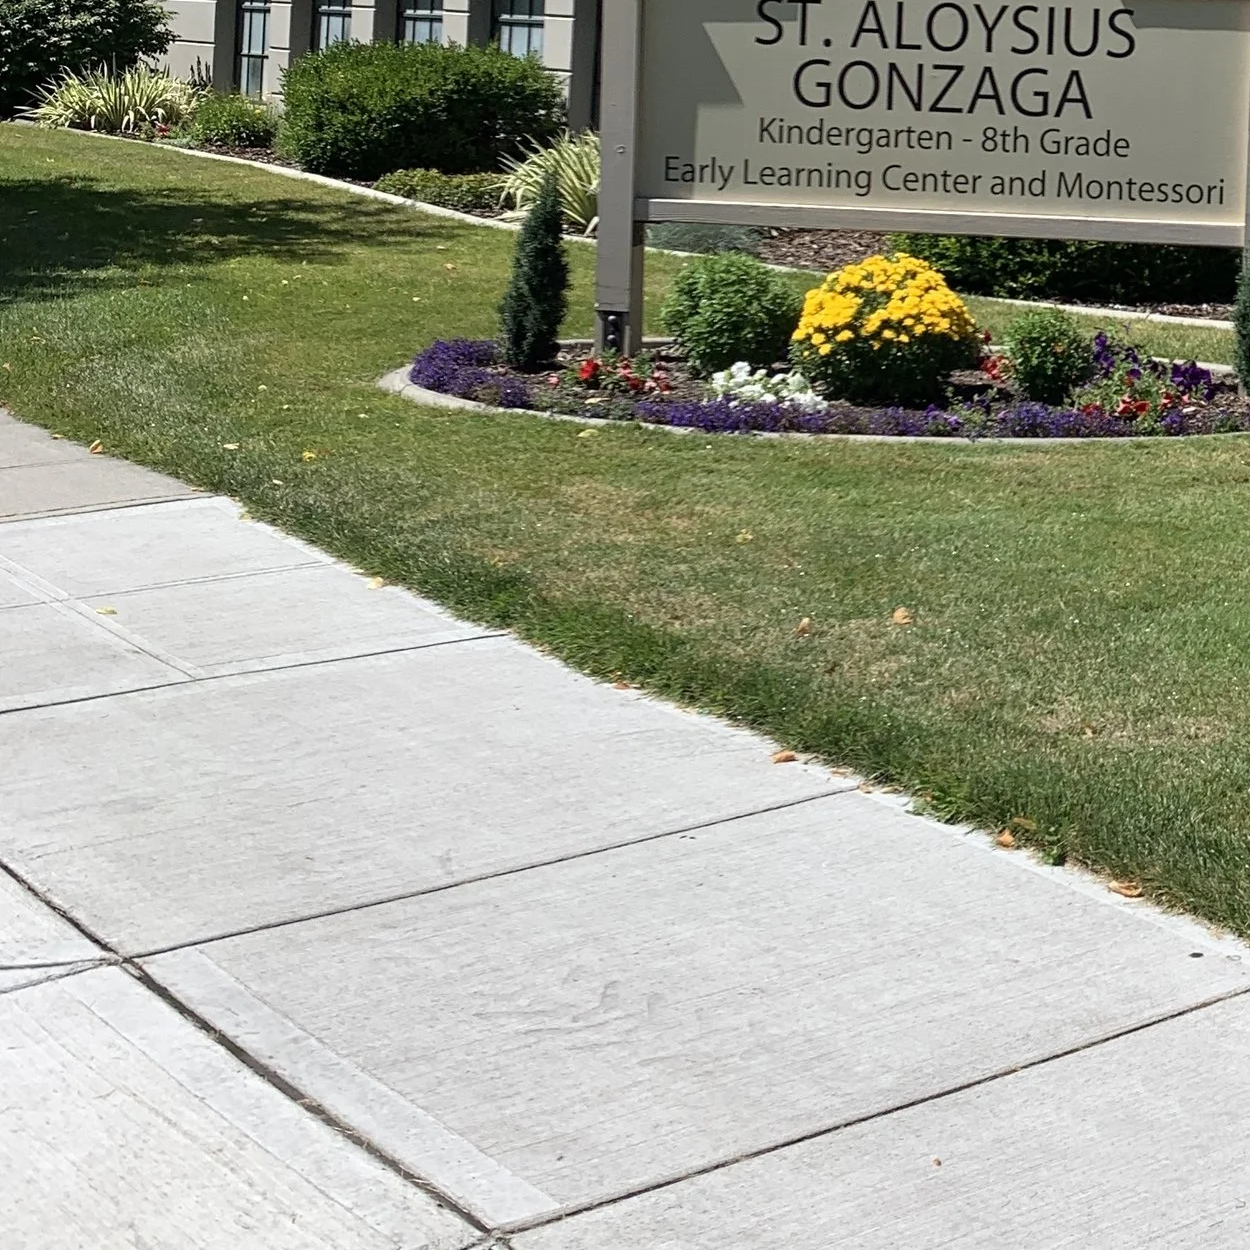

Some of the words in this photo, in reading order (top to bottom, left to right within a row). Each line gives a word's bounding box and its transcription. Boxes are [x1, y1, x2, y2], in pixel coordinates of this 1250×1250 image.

[850, 0, 1136, 58] ALOYSIUS
[793, 58, 1094, 119] GONZAGA
[758, 116, 953, 155] Kindergarten
[980, 125, 1030, 154] 8th
[1039, 128, 1131, 158] Grade
[663, 155, 735, 191] Early
[742, 158, 873, 197] Learning
[881, 164, 983, 195] Center
[989, 169, 1047, 198] and
[1056, 171, 1226, 206] Montessori
